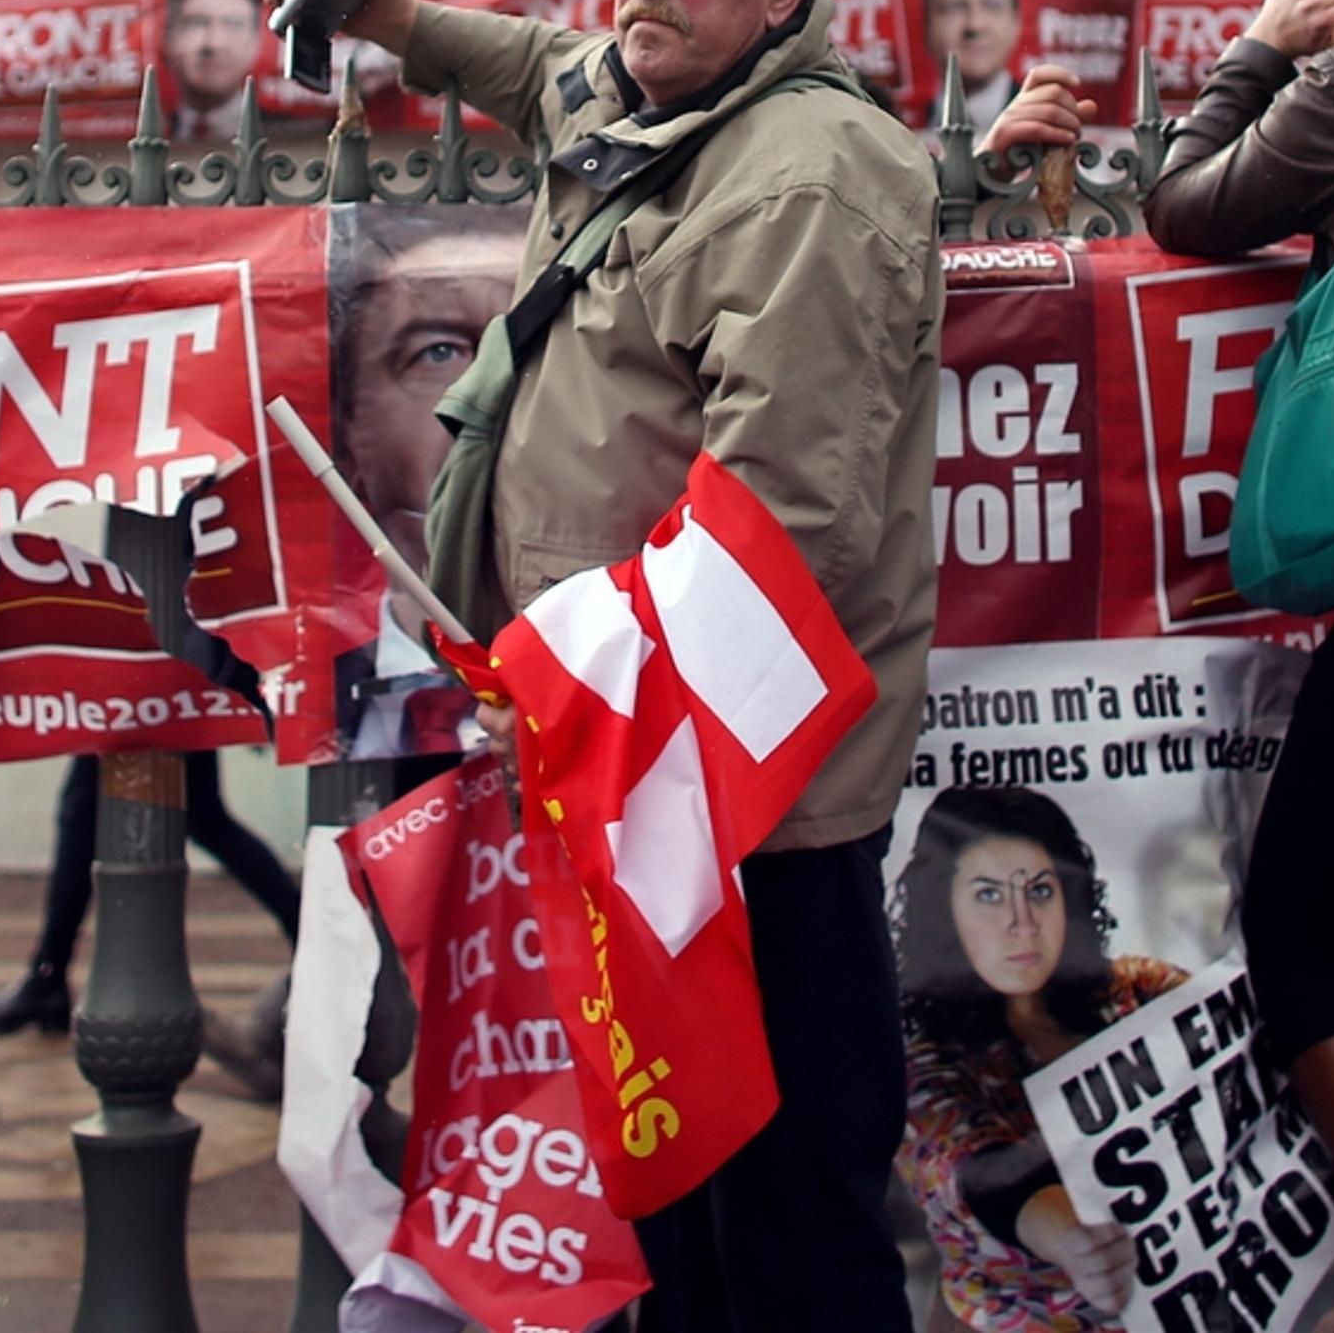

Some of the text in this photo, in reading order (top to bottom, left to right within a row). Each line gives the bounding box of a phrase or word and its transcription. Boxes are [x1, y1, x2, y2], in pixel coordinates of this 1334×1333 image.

[1151, 5, 1267, 57] FRO
[937, 363, 1081, 459] nez
[1051, 677, 1121, 724] m'a
[1133, 673, 1183, 719] dit
[951, 741, 1089, 788] fermes
[1101, 739, 1149, 779] ou
[1158, 734, 1196, 775] tu
[364, 797, 449, 860] avec
[1060, 1036, 1164, 1136] UN
[428, 1186, 588, 1287] vies
